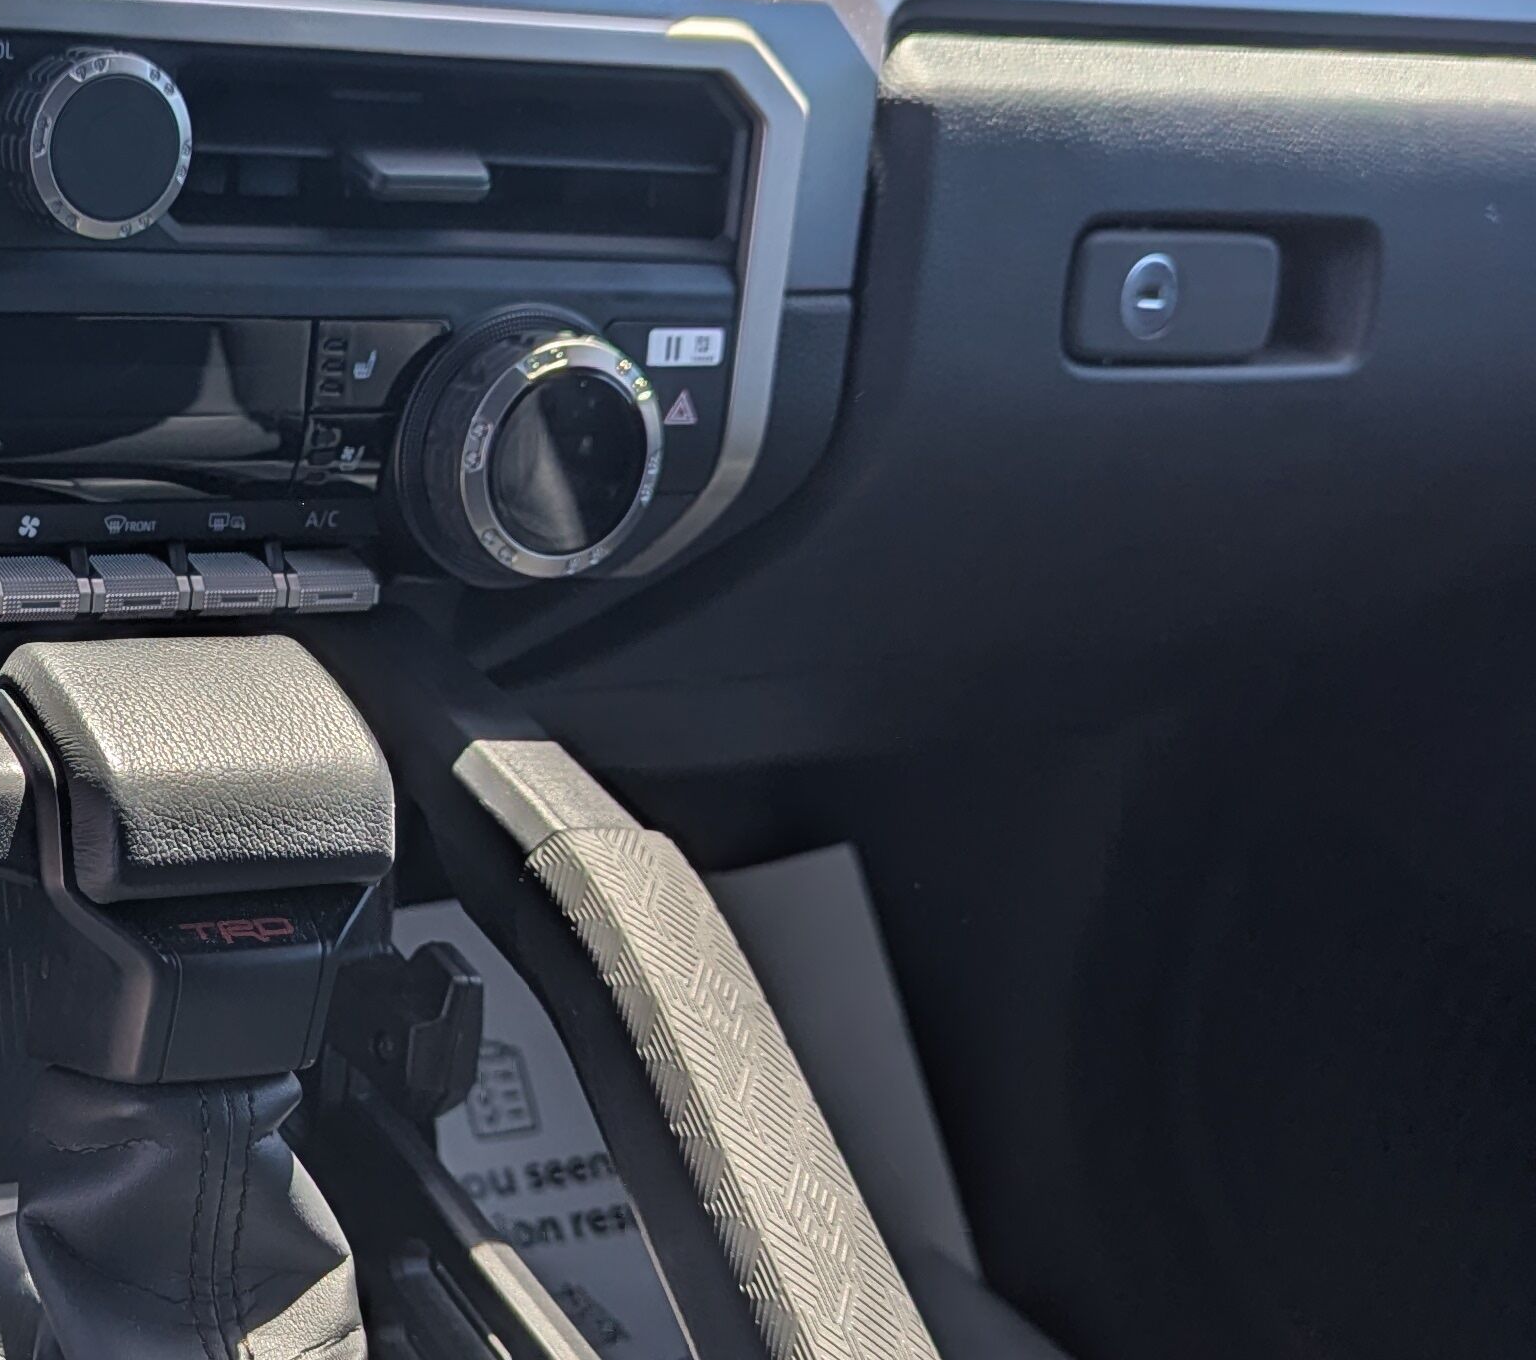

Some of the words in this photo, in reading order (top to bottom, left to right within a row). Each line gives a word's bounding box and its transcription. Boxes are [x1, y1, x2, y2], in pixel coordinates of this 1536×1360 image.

[125, 519, 156, 533] FRONT
[305, 509, 340, 528] A/C
[179, 917, 295, 944] TRD
